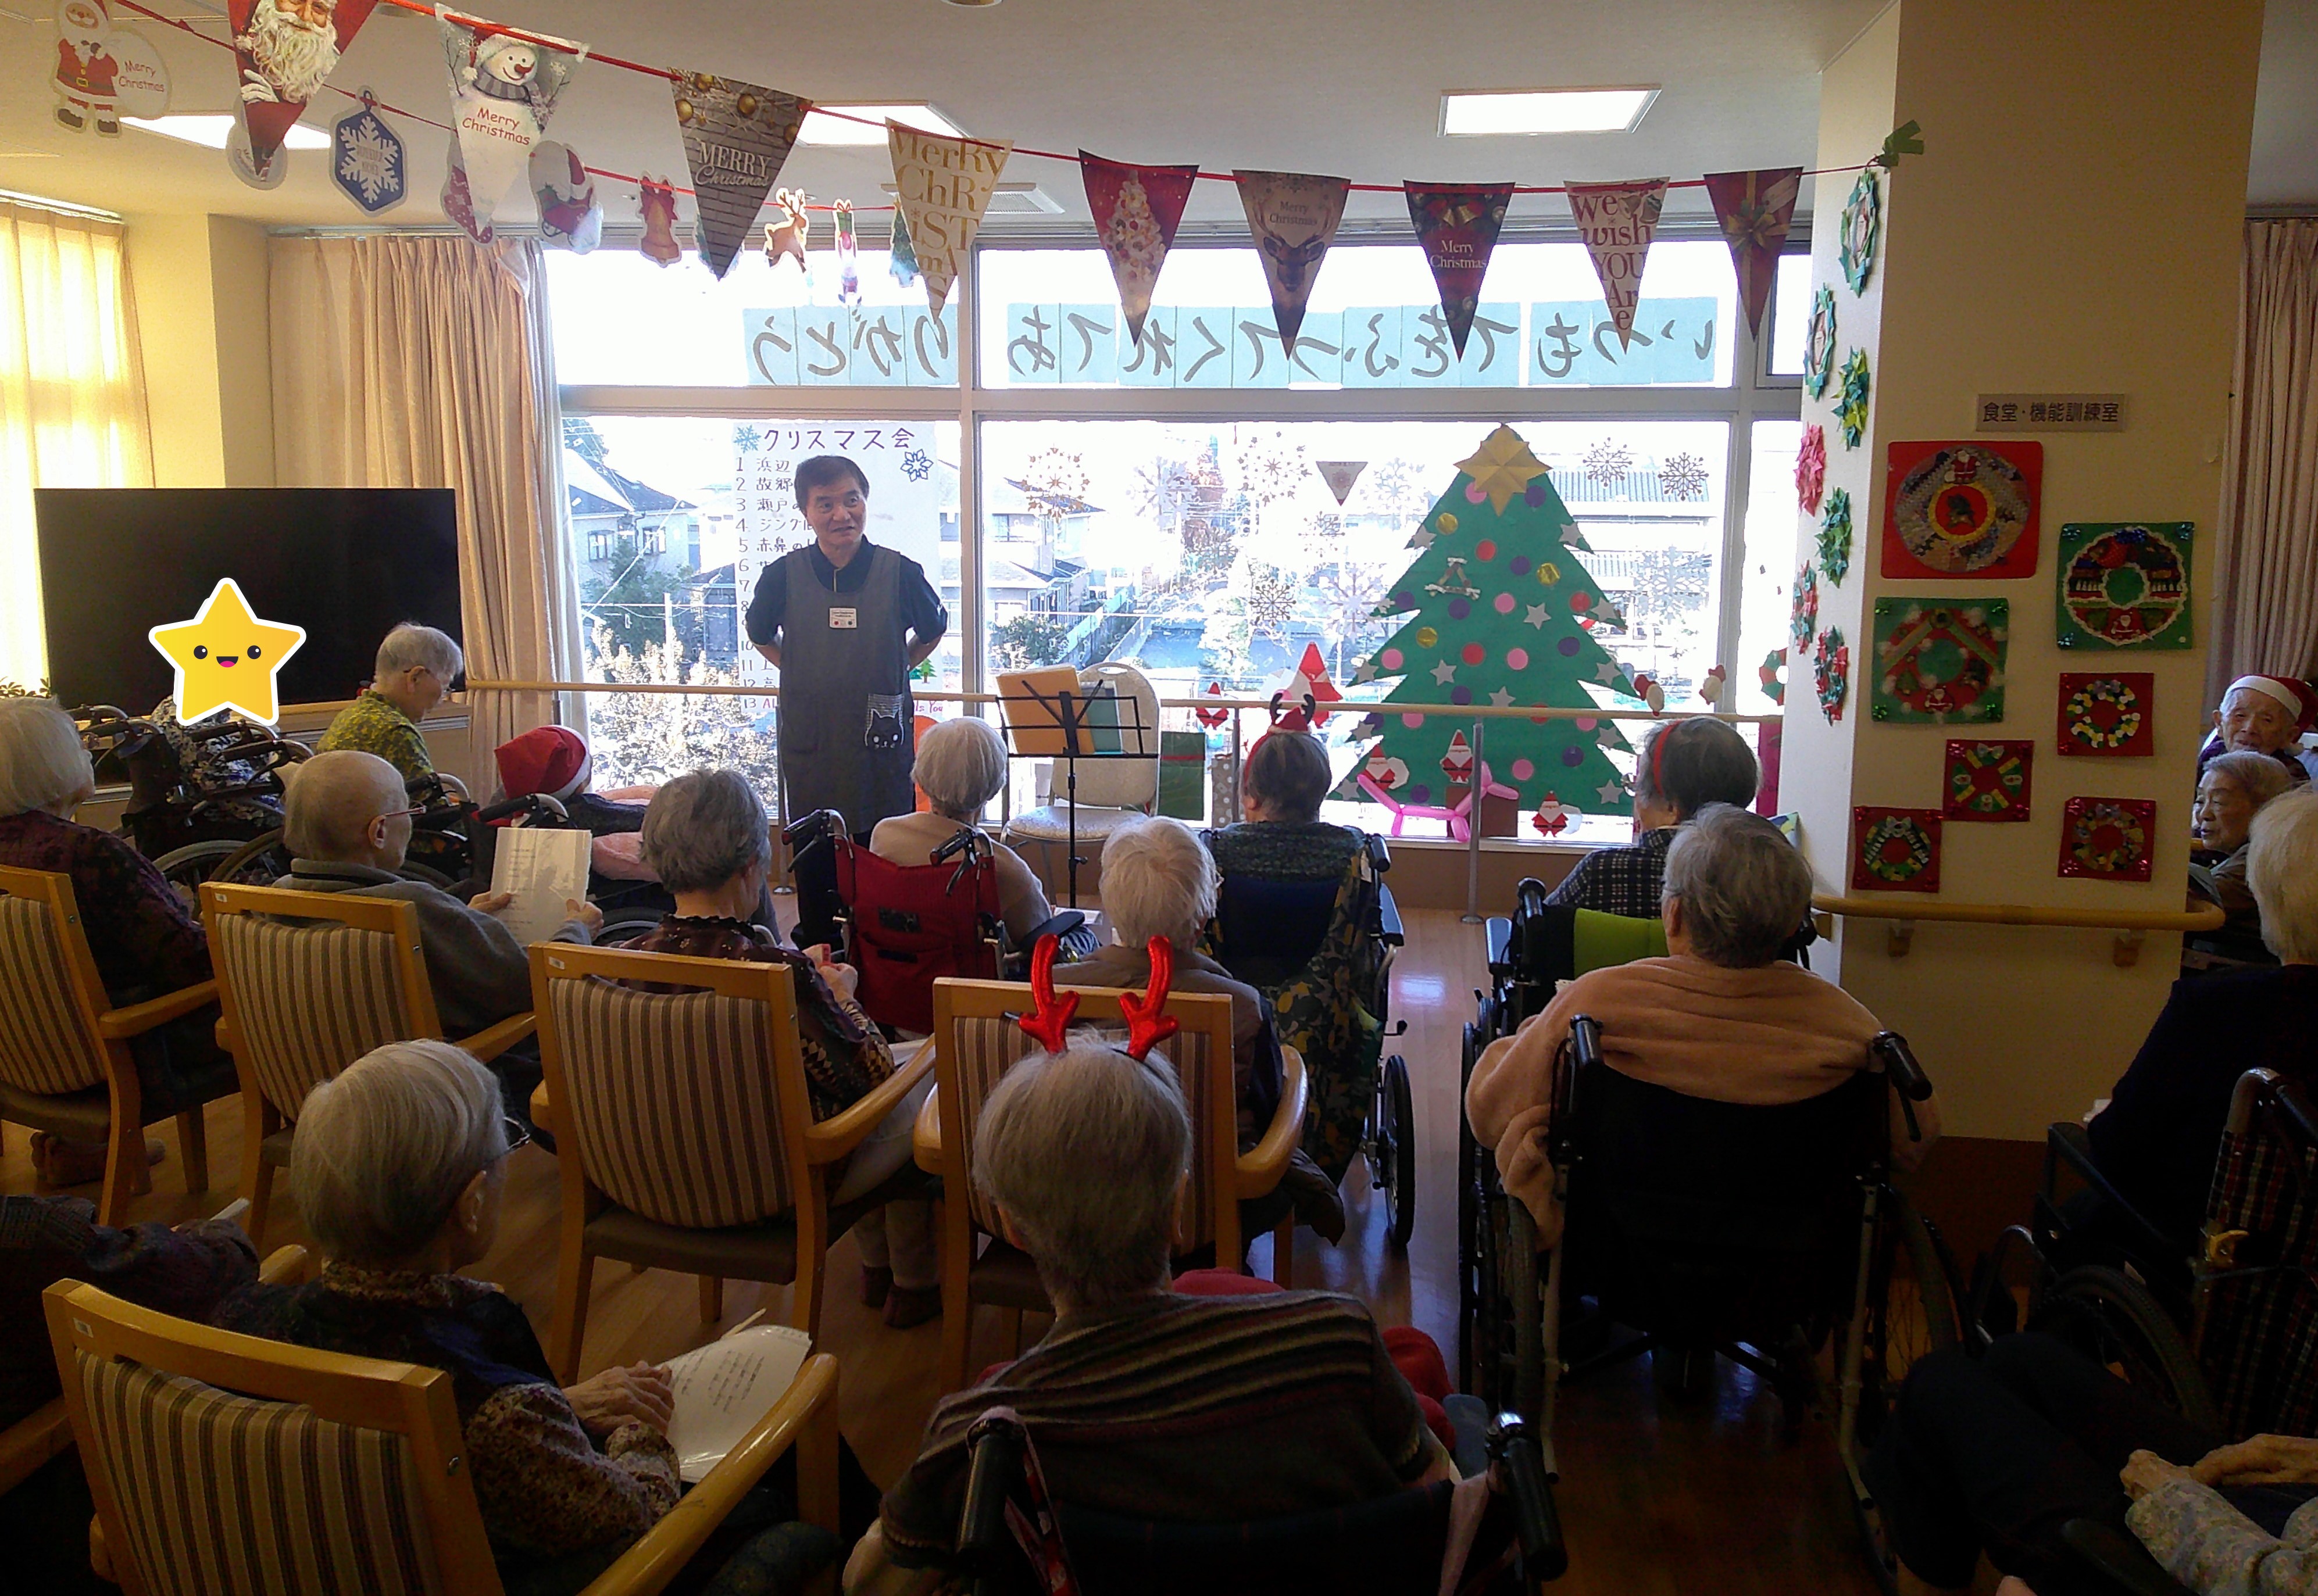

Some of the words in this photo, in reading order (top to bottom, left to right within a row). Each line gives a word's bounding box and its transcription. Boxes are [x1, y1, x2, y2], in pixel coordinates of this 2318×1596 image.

[124, 60, 156, 78] Merry
[119, 76, 165, 92] Christmas
[477, 107, 520, 131] Merry
[462, 117, 530, 145] Christmas
[696, 138, 772, 178] MERRY
[695, 164, 769, 186] Christmas
[1280, 201, 1309, 214] Merry
[1569, 195, 1618, 222] We
[1270, 213, 1317, 226] Christmas
[1580, 214, 1651, 246] wish
[1441, 239, 1473, 257] Merry
[1430, 255, 1487, 268] Christmas
[1593, 252, 1648, 281] YOU
[1983, 402, 2119, 423] 食堂・機能訓練室
[764, 427, 915, 452] クリスマス会
[736, 477, 747, 491] 2
[735, 498, 746, 511] 3
[739, 537, 748, 553] 5
[739, 559, 749, 572] 6
[739, 579, 750, 592] 7
